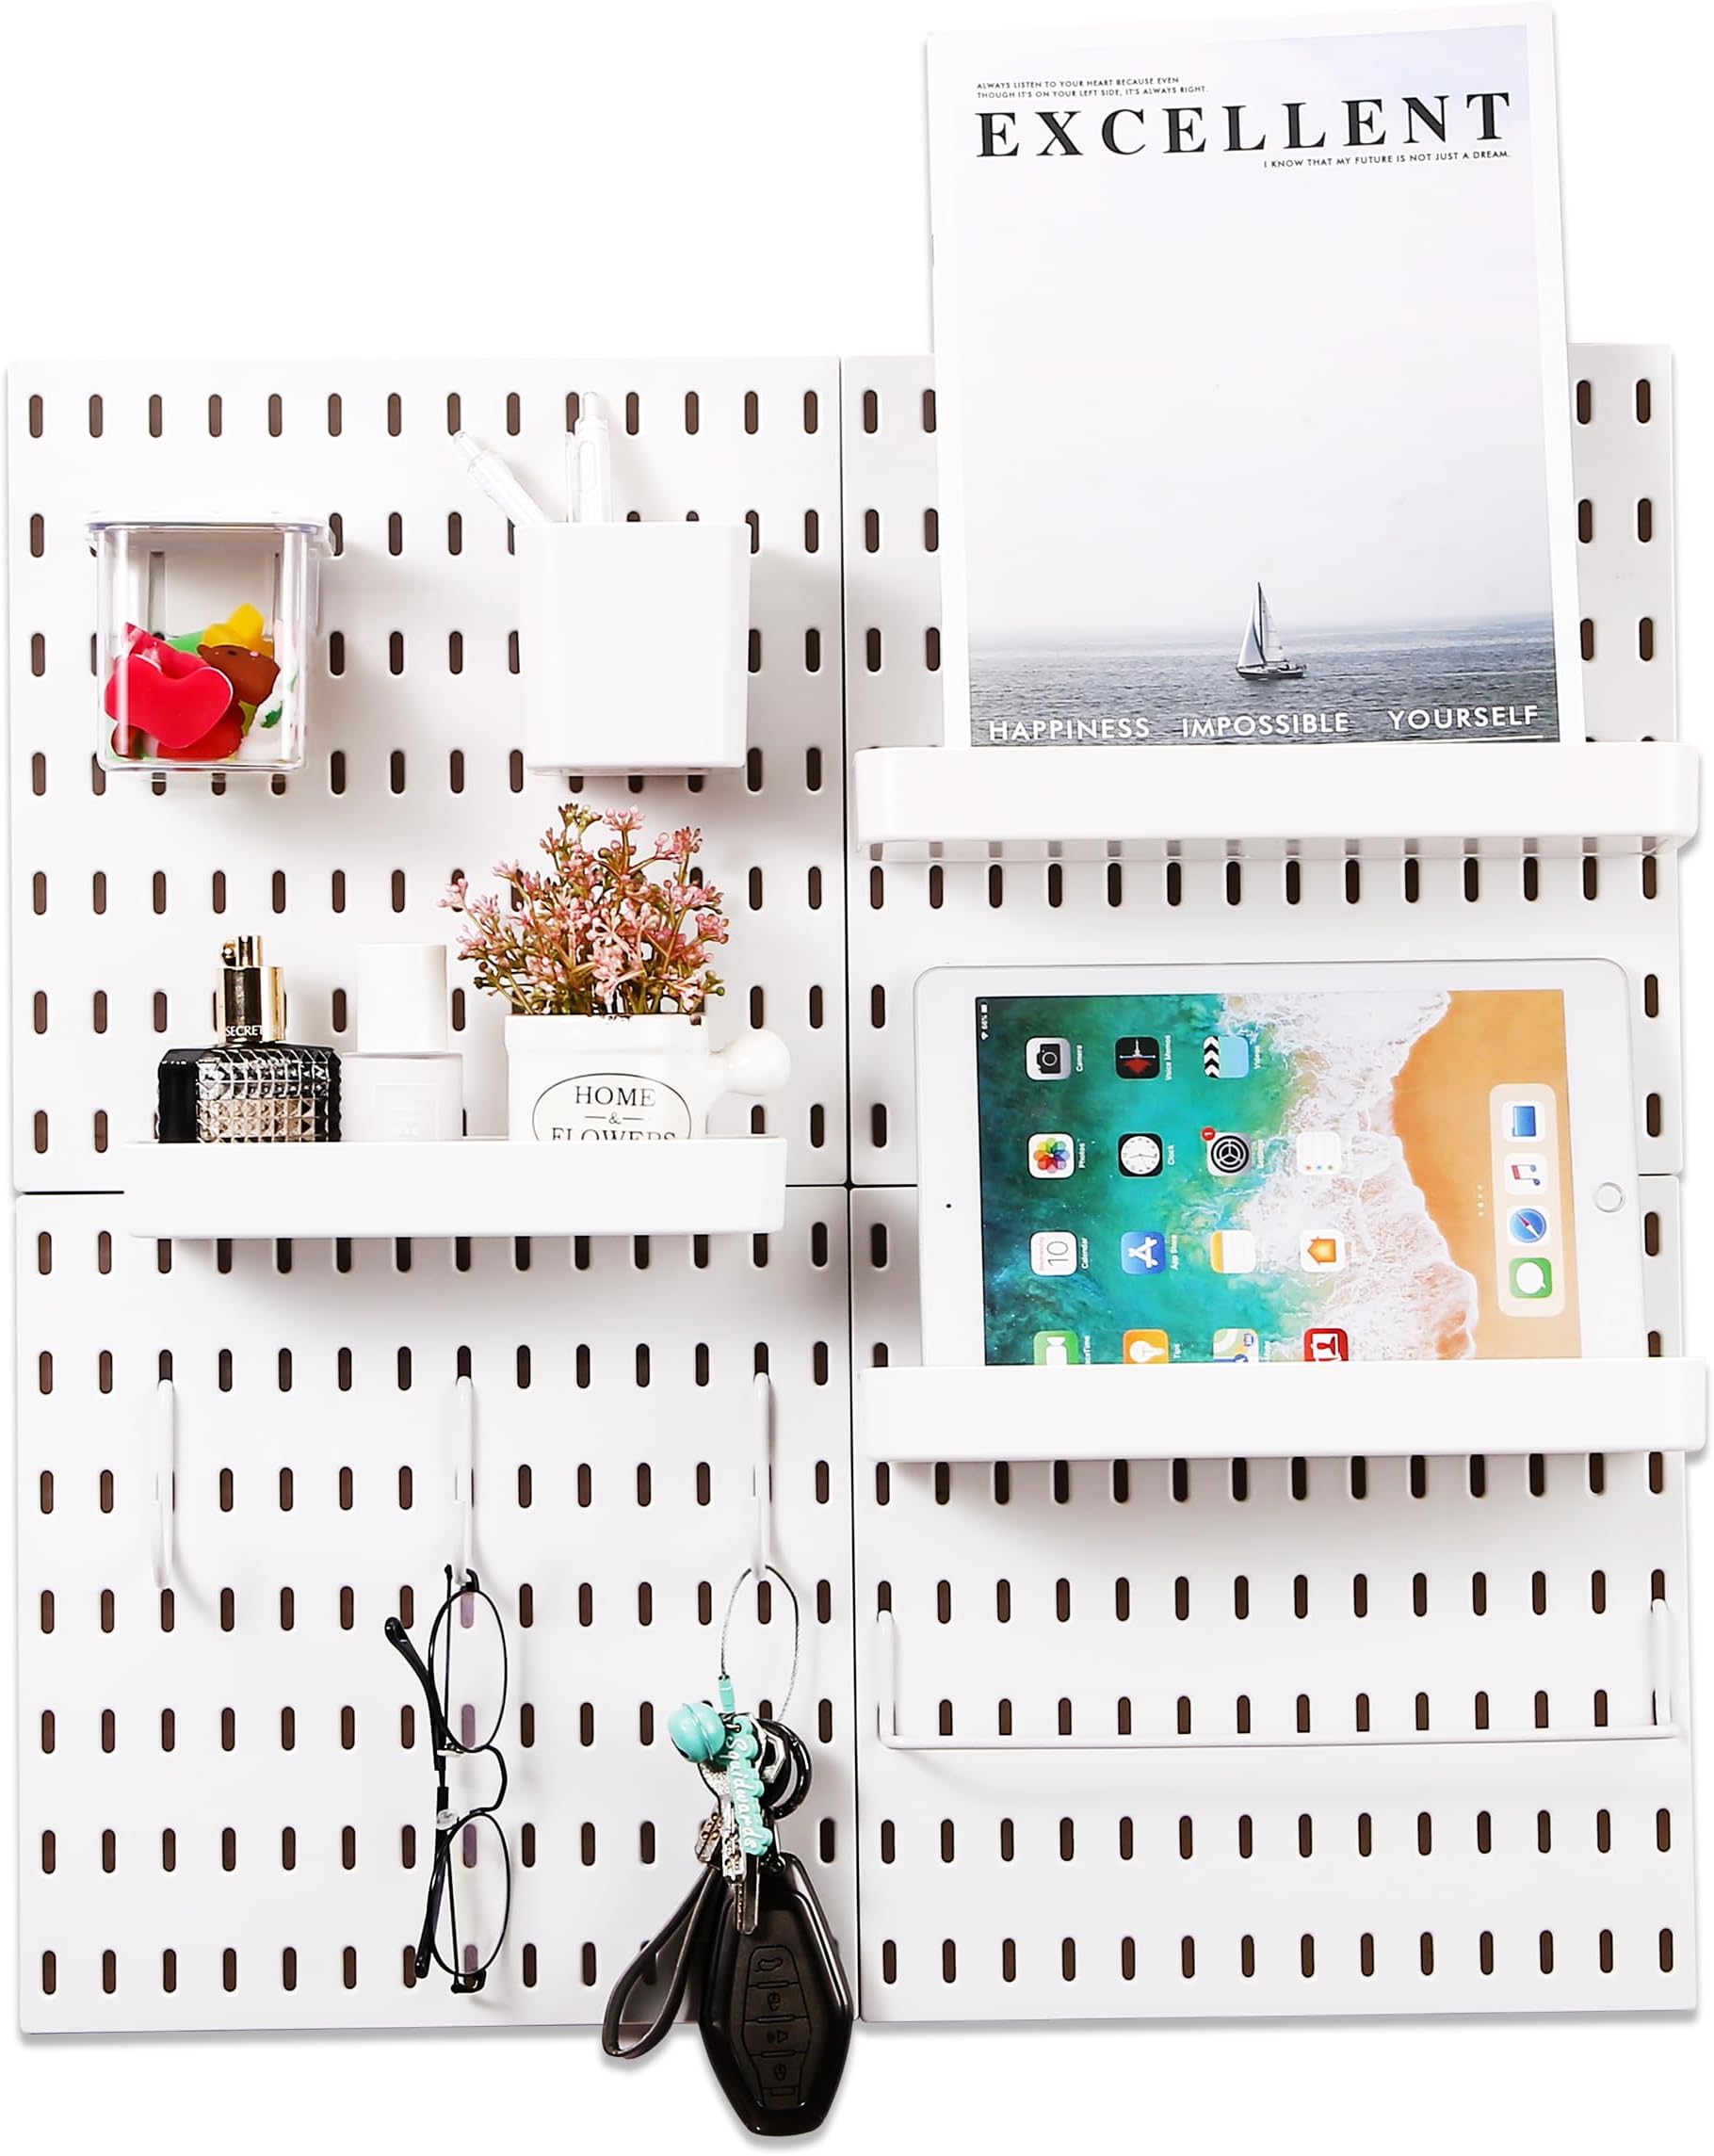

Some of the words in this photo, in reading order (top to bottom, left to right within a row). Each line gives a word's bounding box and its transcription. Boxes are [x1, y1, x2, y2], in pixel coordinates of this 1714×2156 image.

[1101, 89, 1124, 97] SIDE,
[1142, 87, 1177, 95] ALWAYS
[1116, 77, 1155, 86] BECAUSE
[1157, 76, 1179, 85] EVEN
[975, 91, 1511, 157] EXCELLENT
[1264, 160, 1268, 169] I
[1271, 159, 1303, 168] KNOW
[1307, 157, 1333, 166] THAT
[1355, 155, 1393, 165] FUTURE
[1397, 154, 1405, 163] IS
[1409, 154, 1431, 162] NOT
[1435, 152, 1459, 161] JUST
[1473, 151, 1512, 159] DREAM.
[988, 717, 1151, 742] HAPPINESS
[1181, 712, 1350, 738] IMPOSSIBLE
[1387, 705, 1539, 732] YOURSELF
[1164, 1062, 1172, 1081] Voice
[574, 1085, 656, 1108] HOME
[608, 1111, 622, 1125] &
[1046, 1240, 1069, 1267] 10
[1080, 1237, 1090, 1270] Calendar
[719, 1735, 764, 1849] Squidwards
